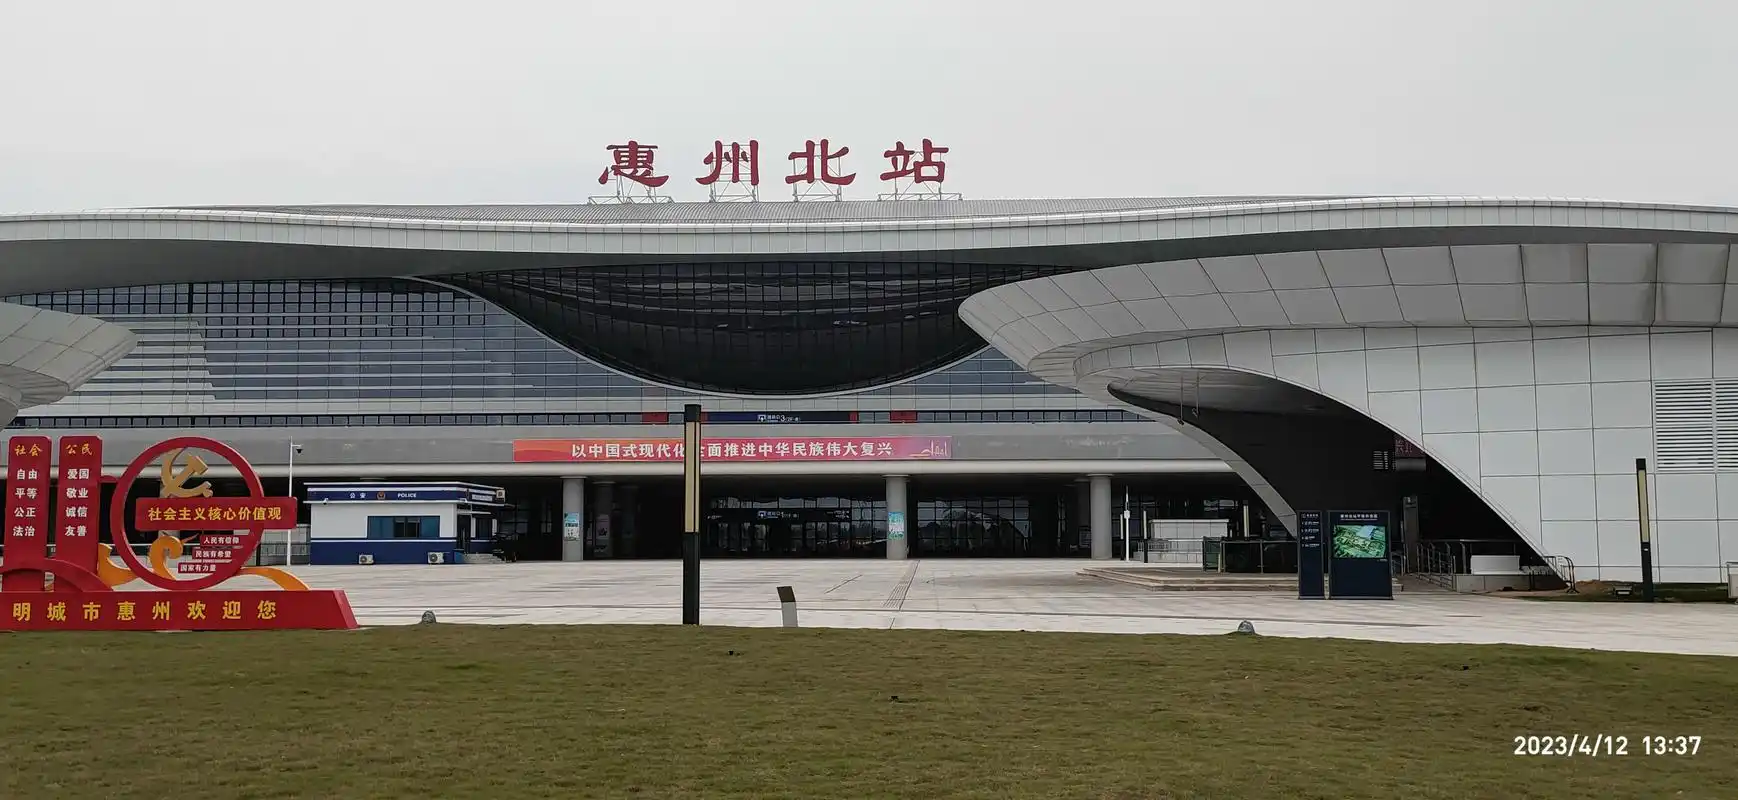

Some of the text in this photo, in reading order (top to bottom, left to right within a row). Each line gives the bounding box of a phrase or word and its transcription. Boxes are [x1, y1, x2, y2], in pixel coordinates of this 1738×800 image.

[598, 139, 949, 187] 惠州北站
[14, 443, 42, 457] 社会
[65, 443, 93, 456] 公民
[16, 468, 38, 480] 自由
[67, 468, 90, 480] 爱国
[15, 487, 38, 499] 平等
[66, 487, 89, 499] 敬业
[13, 507, 36, 518] 公正
[65, 506, 88, 518] 诚信
[148, 506, 282, 521] 社会主义核心价值观
[12, 525, 36, 537] 法治
[64, 525, 88, 537] 友善
[180, 564, 217, 572] 国家有力量
[12, 600, 277, 622] 明城市惠州欢迎您
